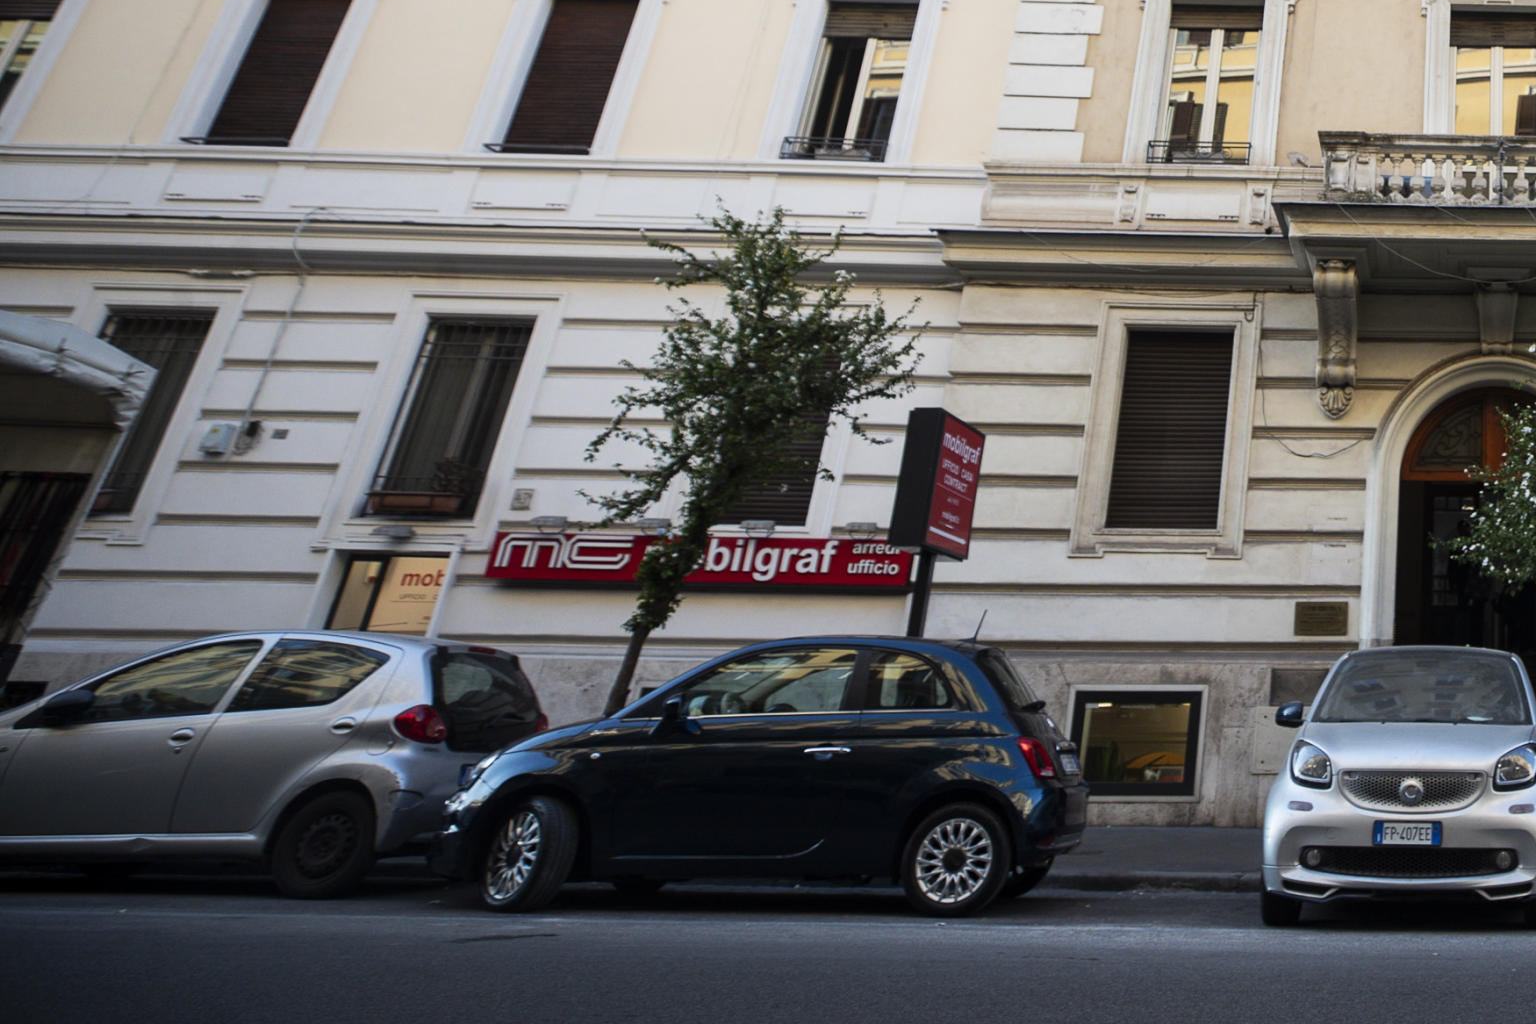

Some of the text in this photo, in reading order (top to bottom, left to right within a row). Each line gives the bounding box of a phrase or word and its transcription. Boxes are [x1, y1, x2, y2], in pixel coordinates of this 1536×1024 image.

[943, 432, 980, 464] mobilgraf
[644, 538, 839, 581] bilgraf
[847, 559, 899, 575] ufficio
